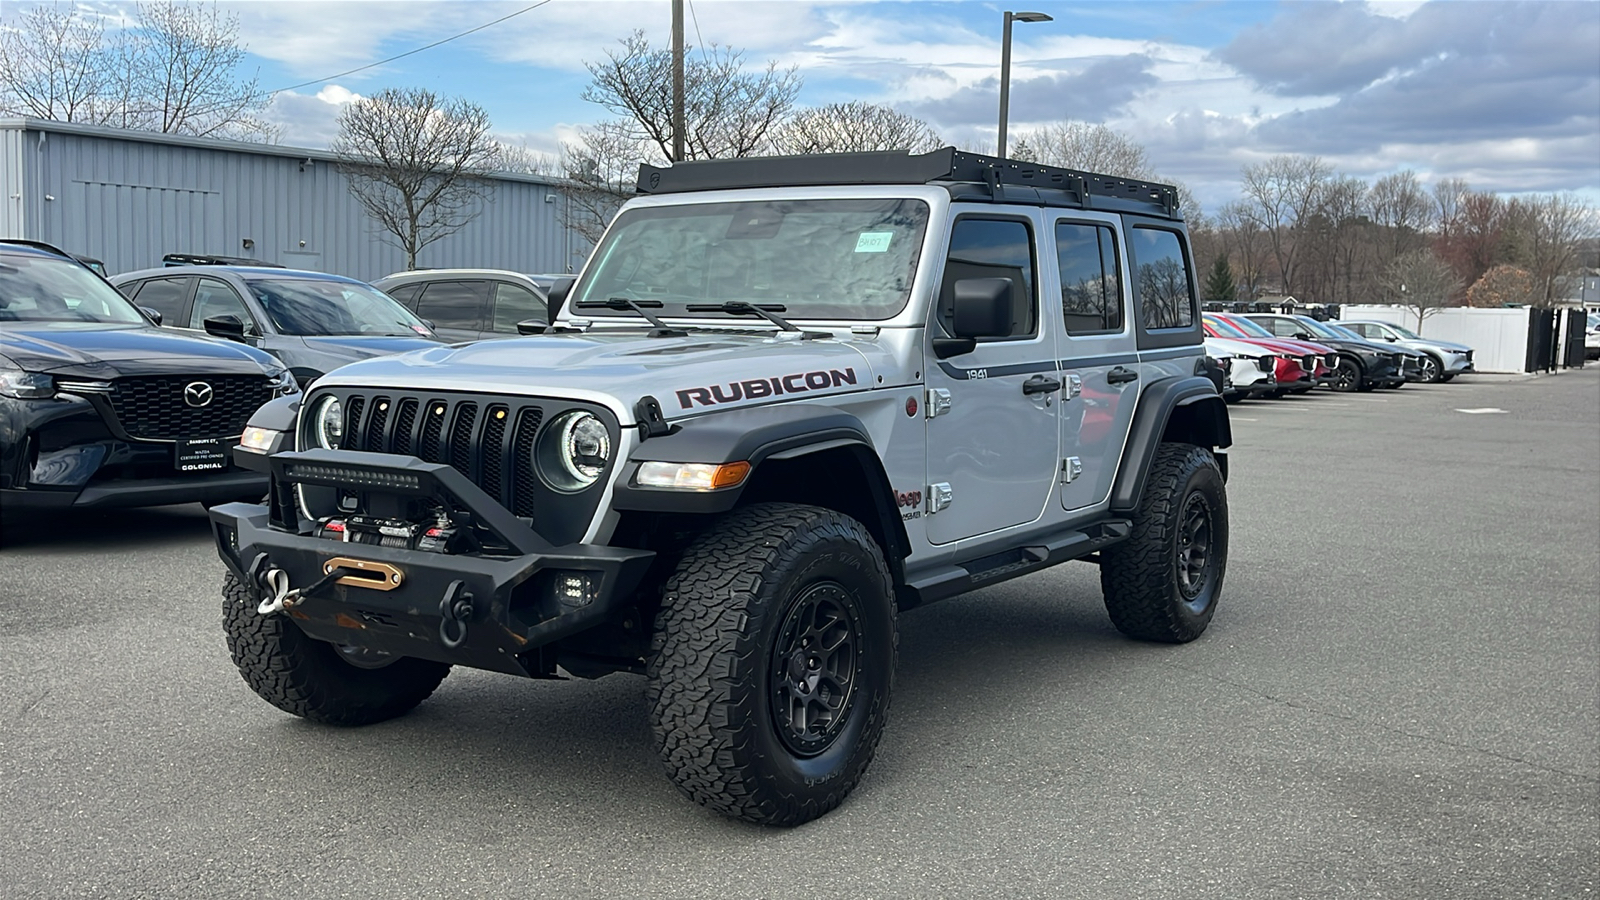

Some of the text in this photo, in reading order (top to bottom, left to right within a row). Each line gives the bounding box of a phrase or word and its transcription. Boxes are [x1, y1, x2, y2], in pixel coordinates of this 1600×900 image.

[966, 368, 988, 380] 1941
[675, 367, 857, 410] RUBICON
[181, 462, 222, 471] COLONIAL
